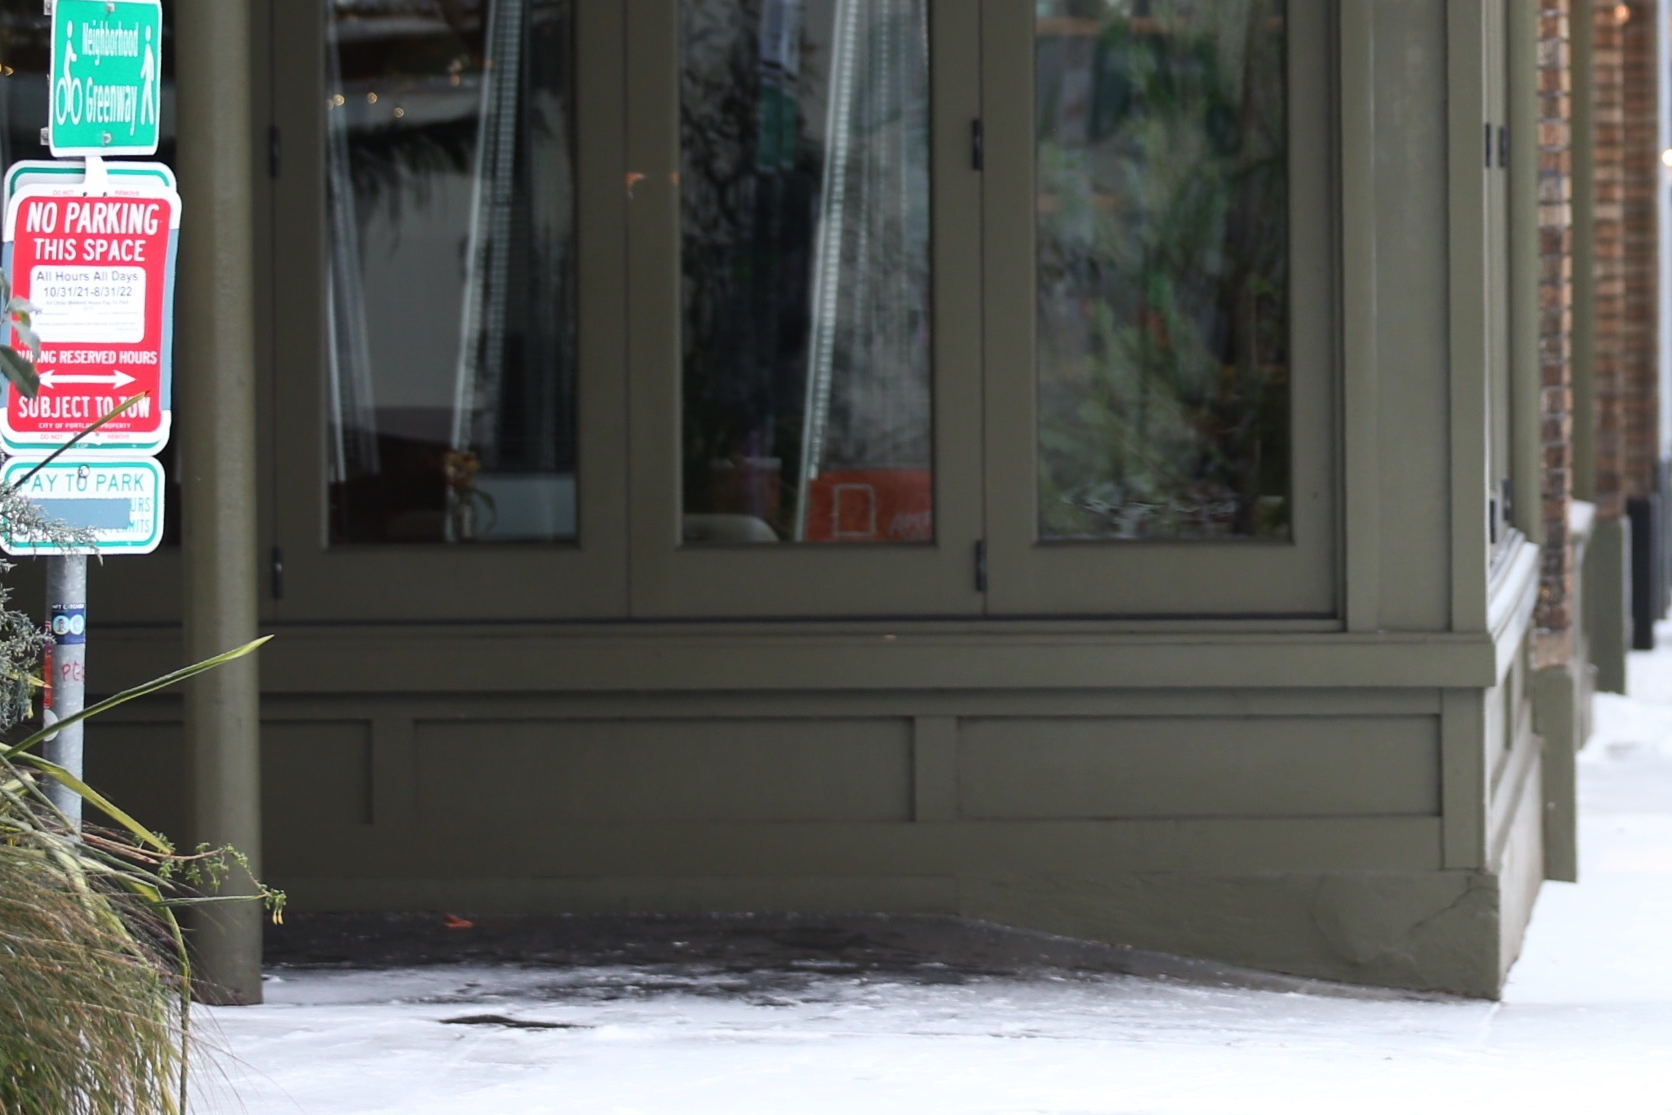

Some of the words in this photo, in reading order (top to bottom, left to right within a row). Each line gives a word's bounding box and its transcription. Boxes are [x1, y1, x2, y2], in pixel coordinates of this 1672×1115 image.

[82, 19, 139, 66] Neighborhood
[86, 76, 138, 136] Greenway
[26, 201, 58, 234] NO
[64, 202, 160, 236] PARKING
[33, 238, 77, 261] THIS
[82, 239, 147, 262] SPACE
[36, 271, 52, 281] All
[55, 271, 89, 281] Hours
[93, 271, 108, 281] All
[111, 270, 139, 283] Days
[44, 286, 132, 298] 10/31/21-8/31/22
[59, 350, 117, 364] RESERVED
[119, 350, 158, 365] HOURS
[18, 396, 91, 419] SUBJECT
[95, 396, 114, 418] TO
[119, 396, 151, 419] TOW
[19, 474, 58, 492] PAY
[66, 474, 87, 492] TO
[96, 473, 145, 492] PARK
